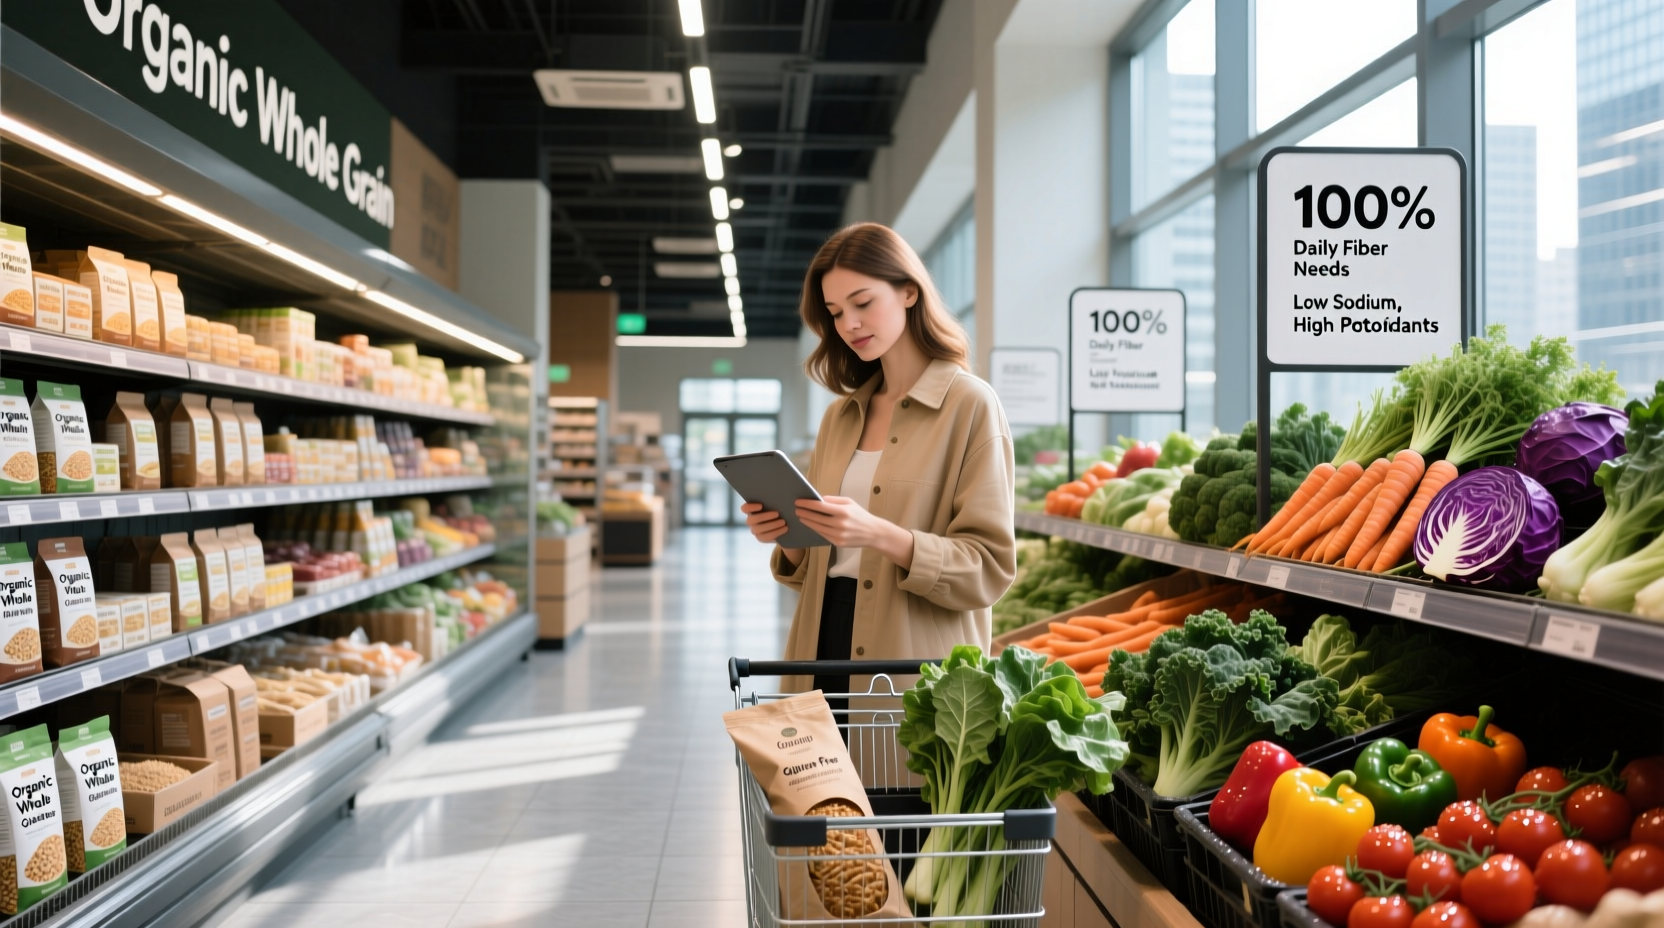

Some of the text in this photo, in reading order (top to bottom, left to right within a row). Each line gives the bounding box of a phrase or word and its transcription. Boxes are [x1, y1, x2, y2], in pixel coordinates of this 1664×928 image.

[256, 66, 340, 191] Whole
[343, 143, 395, 229] Grain
[1294, 184, 1436, 230] 100%
[1294, 239, 1388, 259] Daily Fiber
[1294, 260, 1350, 277] Needs
[1293, 293, 1402, 313] Low Sodium,
[1089, 309, 1167, 334] 100%
[1293, 316, 1334, 336] High
